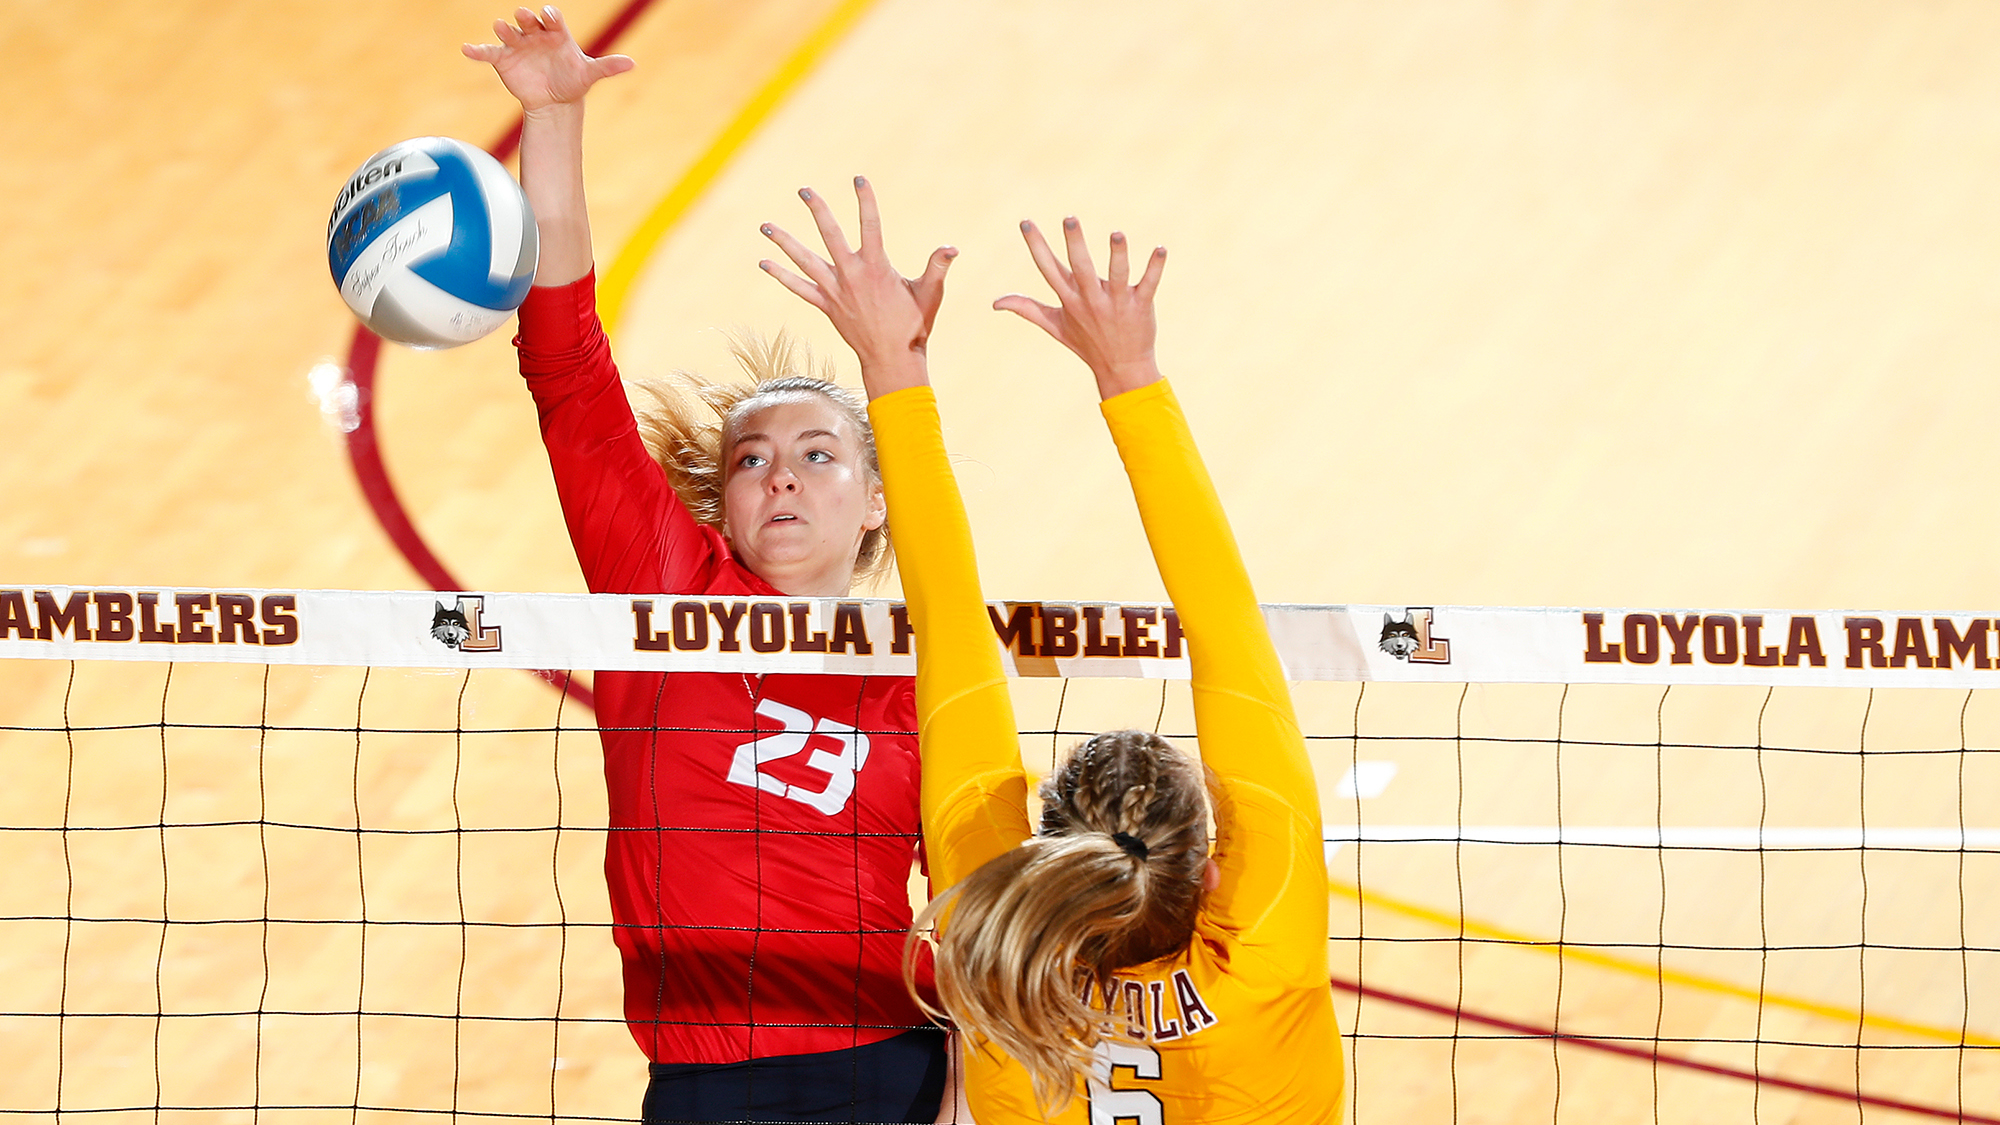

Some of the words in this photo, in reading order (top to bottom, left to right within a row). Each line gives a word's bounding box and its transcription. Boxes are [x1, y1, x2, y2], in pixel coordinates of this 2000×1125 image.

[382, 218, 428, 263] Touch
[0, 590, 300, 645] AMBLERS
[632, 600, 873, 655] LOYOLA
[1582, 612, 1827, 668] LOYOLA
[1843, 616, 2000, 671] RAM
[726, 698, 870, 815] 23
[1072, 966, 1218, 1043] YOLA
[1086, 1040, 1164, 1125] 6
